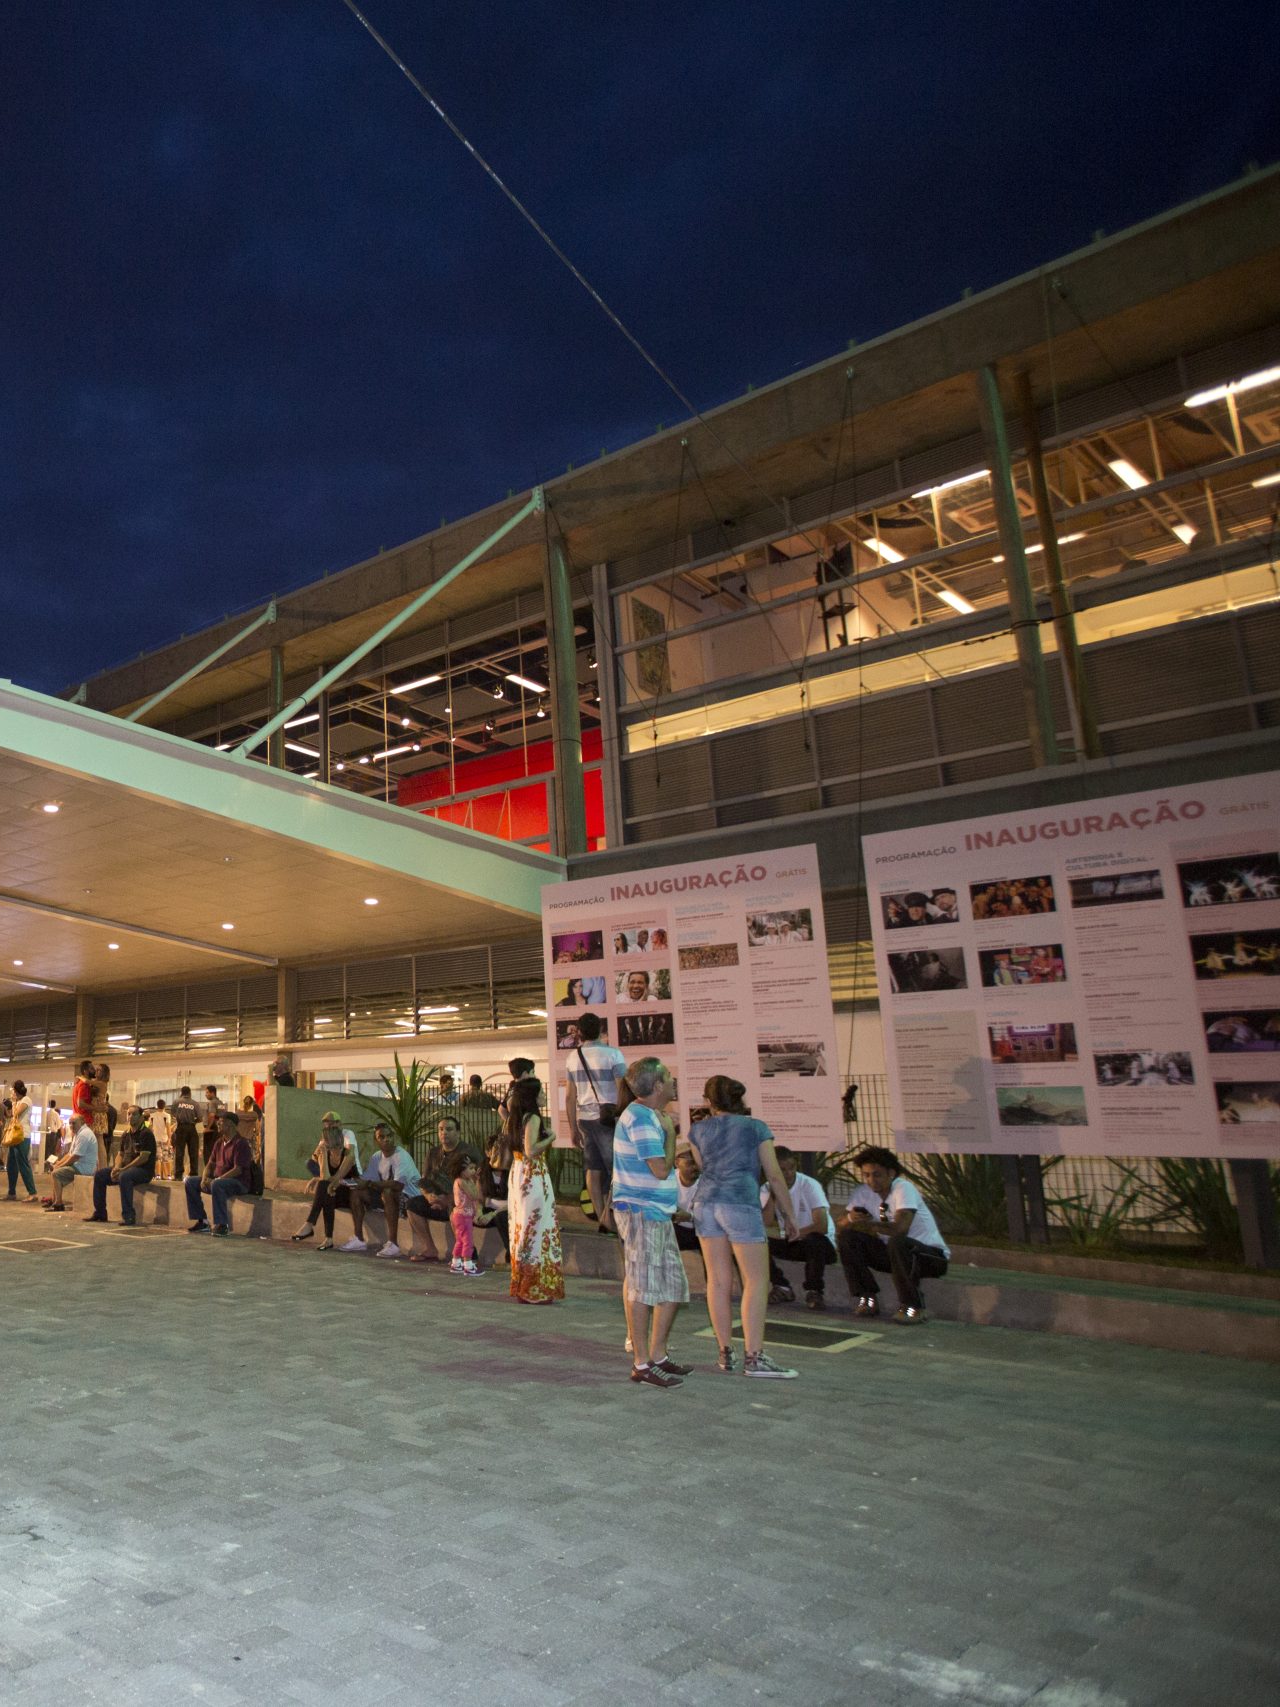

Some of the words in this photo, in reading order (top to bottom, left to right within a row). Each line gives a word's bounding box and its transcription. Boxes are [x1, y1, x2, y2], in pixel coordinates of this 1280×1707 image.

[874, 845, 957, 864] PROGRAMAÇÃO
[964, 799, 1206, 851] INAUGURAÇÃO
[549, 896, 605, 910] PROGRAMAÇÃO
[610, 863, 767, 902] INAUGURAÇÃO
